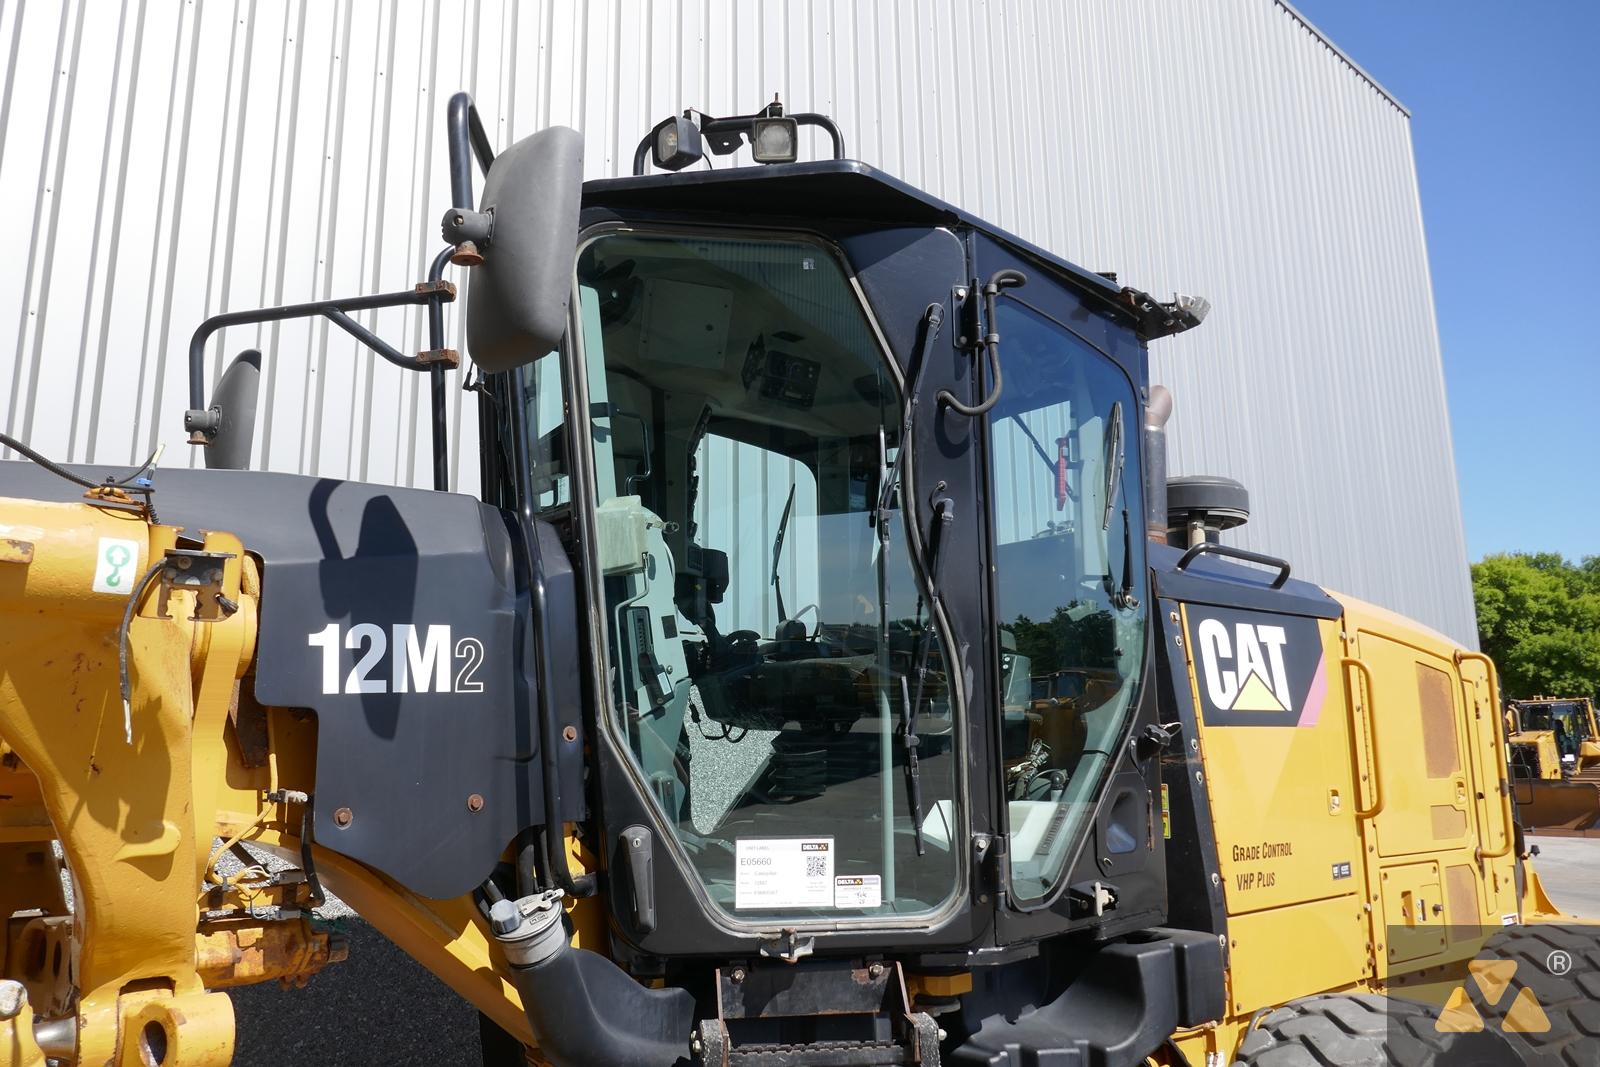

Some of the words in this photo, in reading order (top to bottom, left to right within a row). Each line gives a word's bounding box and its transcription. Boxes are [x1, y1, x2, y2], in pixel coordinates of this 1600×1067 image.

[1198, 618, 1292, 712] CAT
[740, 857, 772, 866] E05660
[1236, 872, 1255, 892] VHP
